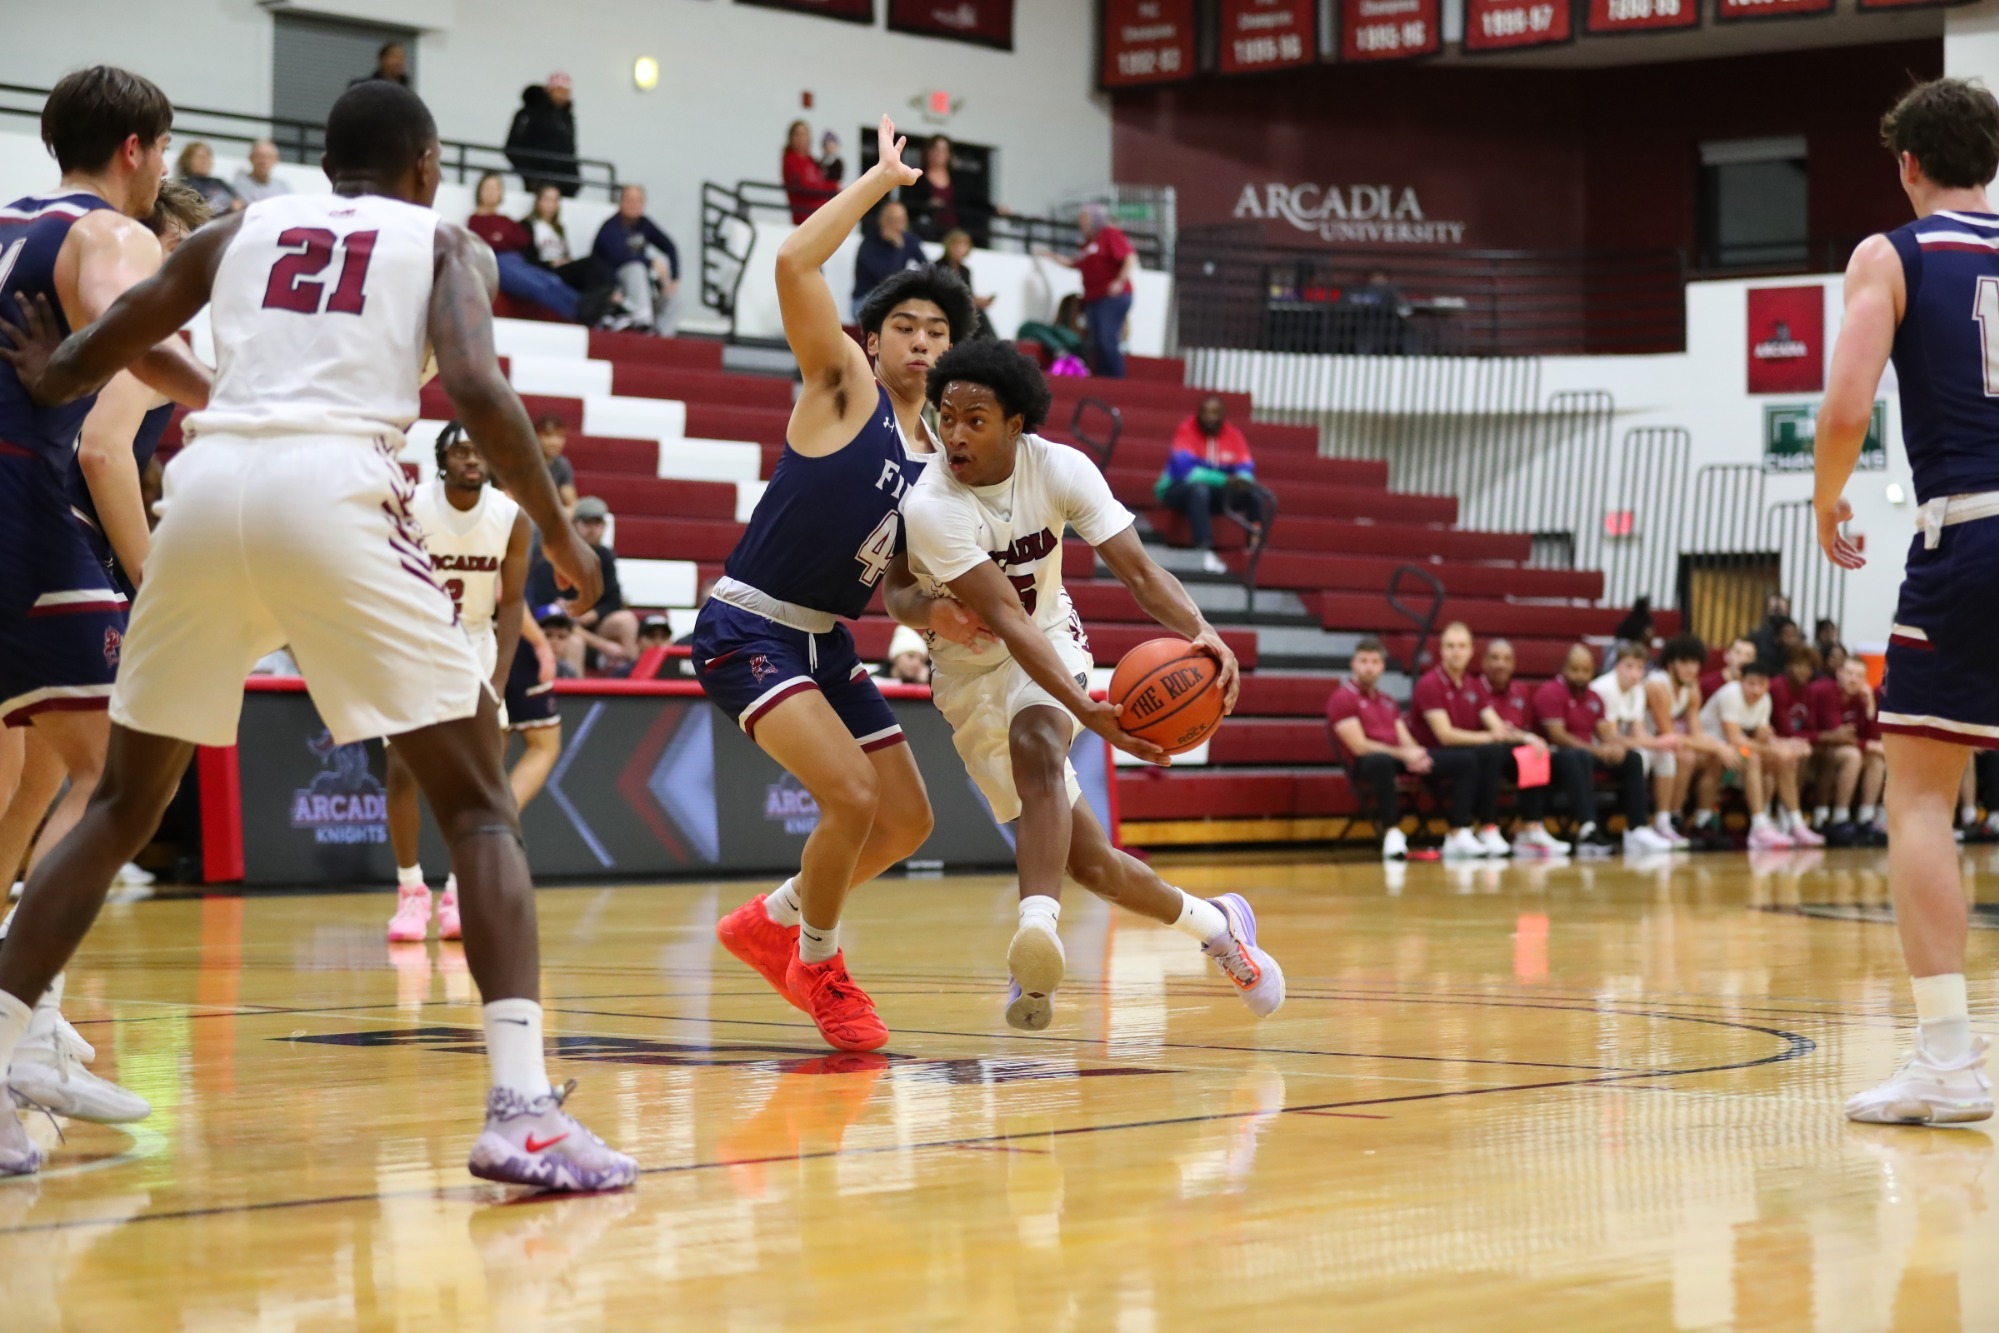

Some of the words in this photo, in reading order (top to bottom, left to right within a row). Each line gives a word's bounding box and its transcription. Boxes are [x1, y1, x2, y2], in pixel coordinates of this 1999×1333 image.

[1233, 183, 1423, 231] ARCADIA
[1320, 220, 1464, 243] UNIVERSITY
[261, 226, 380, 316] 21
[854, 509, 898, 588] 4
[430, 554, 498, 572] RCADIA
[1129, 685, 1165, 720] THE
[1160, 666, 1204, 700] ROCK
[1177, 722, 1207, 745] ROCK
[293, 793, 388, 821] ARCADI
[315, 824, 388, 844] KNIGHTS
